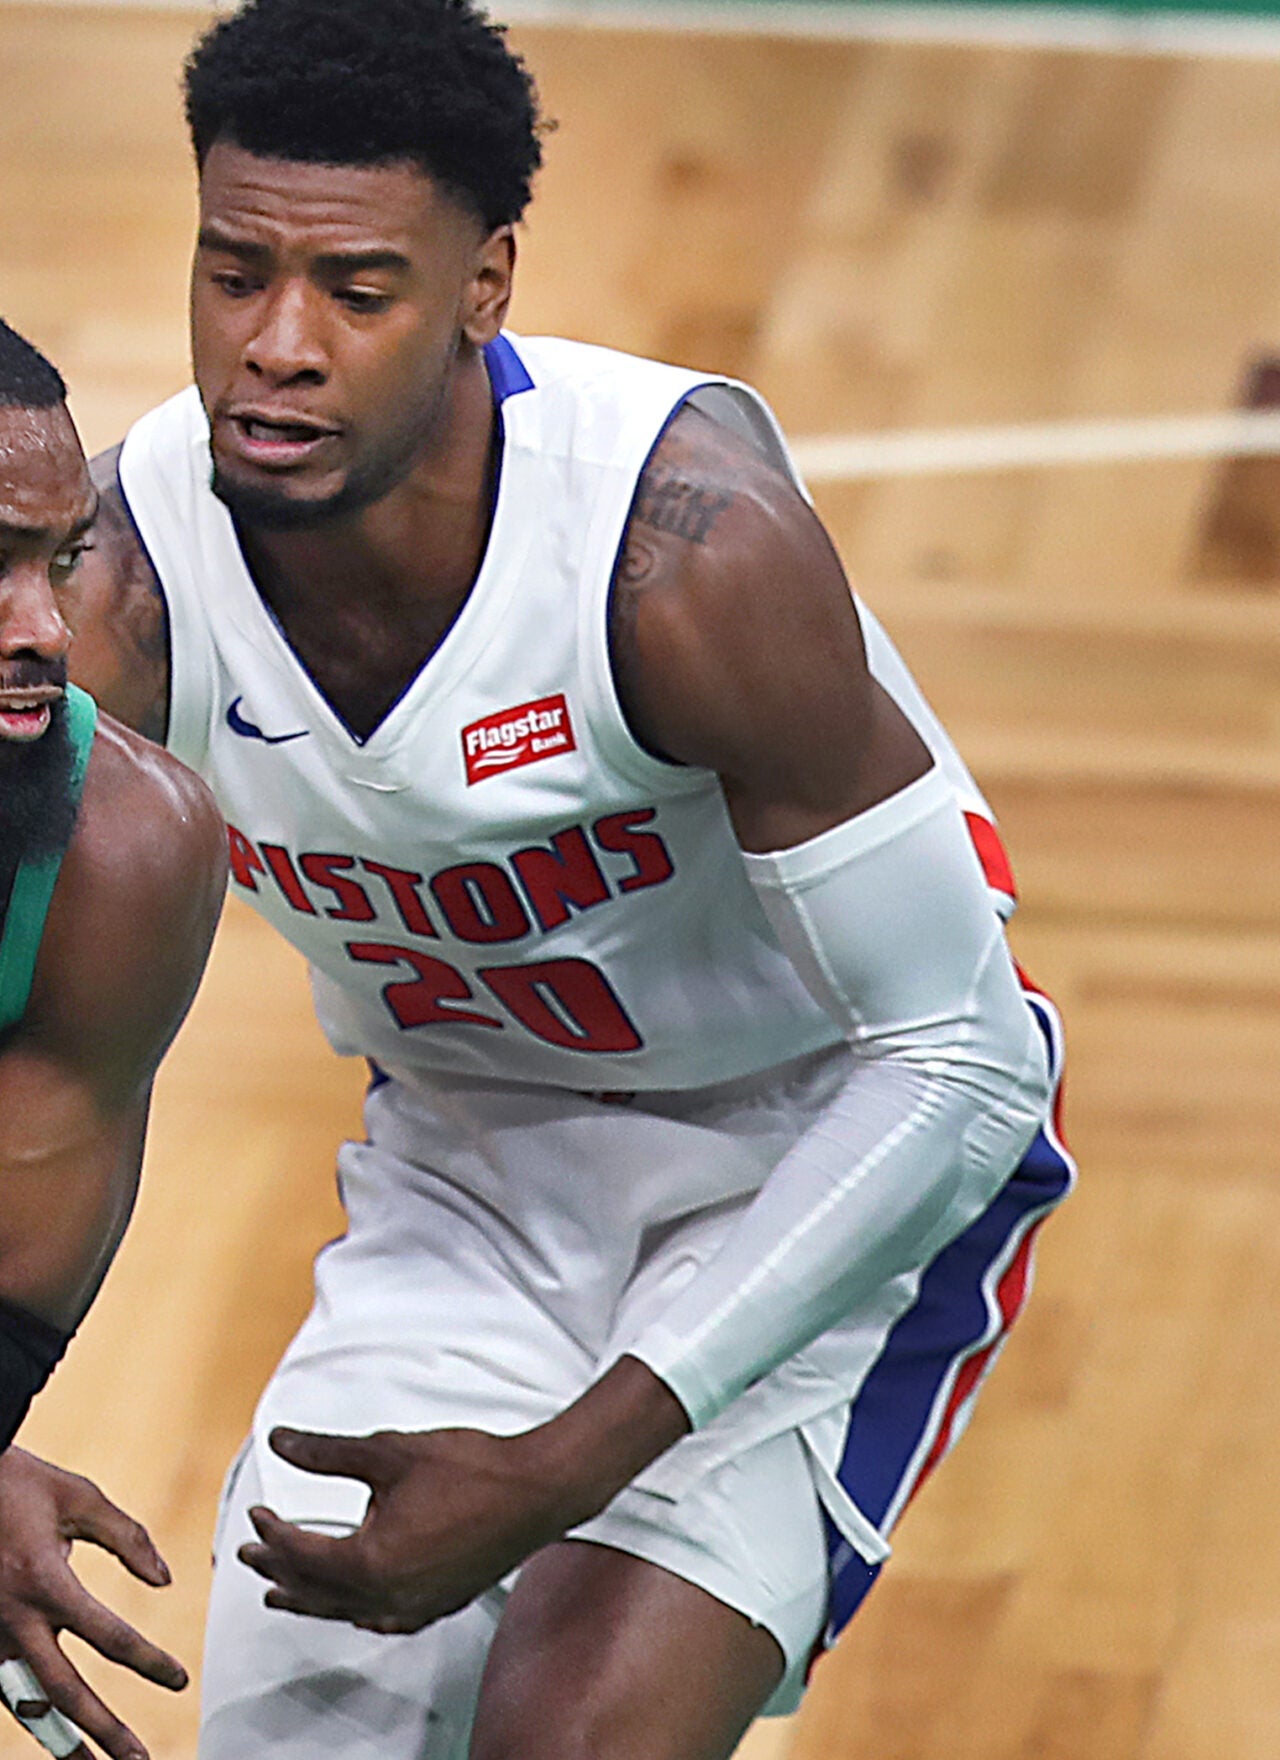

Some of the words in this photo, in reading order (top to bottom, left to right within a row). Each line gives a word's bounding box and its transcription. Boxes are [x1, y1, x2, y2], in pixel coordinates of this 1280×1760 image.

[465, 707, 563, 756] Flagstar
[530, 732, 567, 753] Bank
[227, 807, 676, 942] PISTONS
[345, 941, 645, 1054] 20
